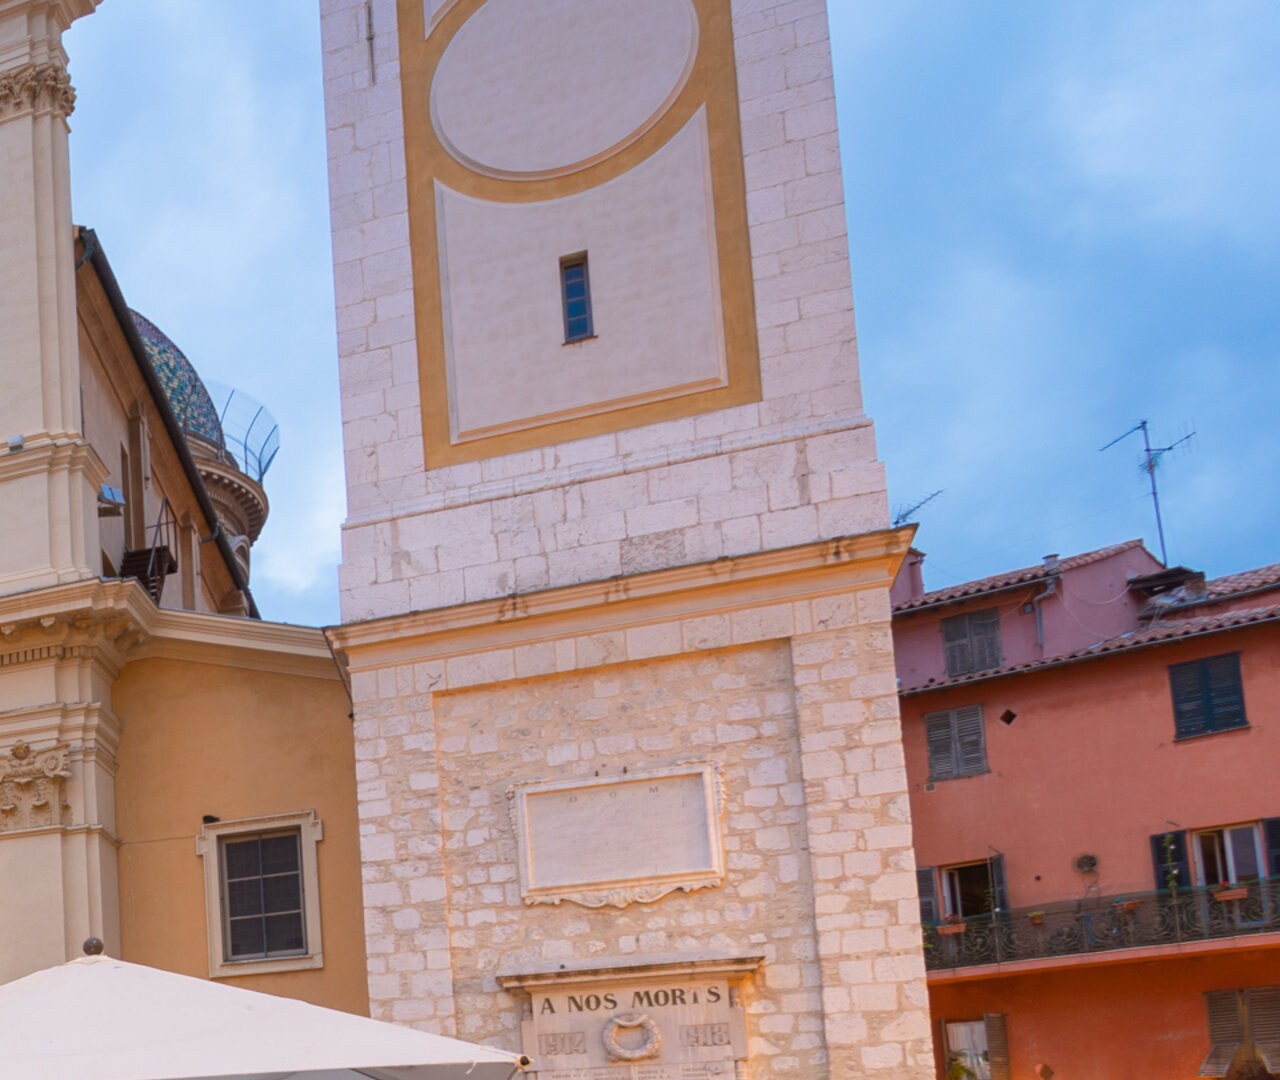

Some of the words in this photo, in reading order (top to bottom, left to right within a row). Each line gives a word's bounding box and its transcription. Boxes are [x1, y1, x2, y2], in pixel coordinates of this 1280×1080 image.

[540, 997, 557, 1015] A
[567, 993, 618, 1013] NOS
[631, 985, 722, 1009] MORTS
